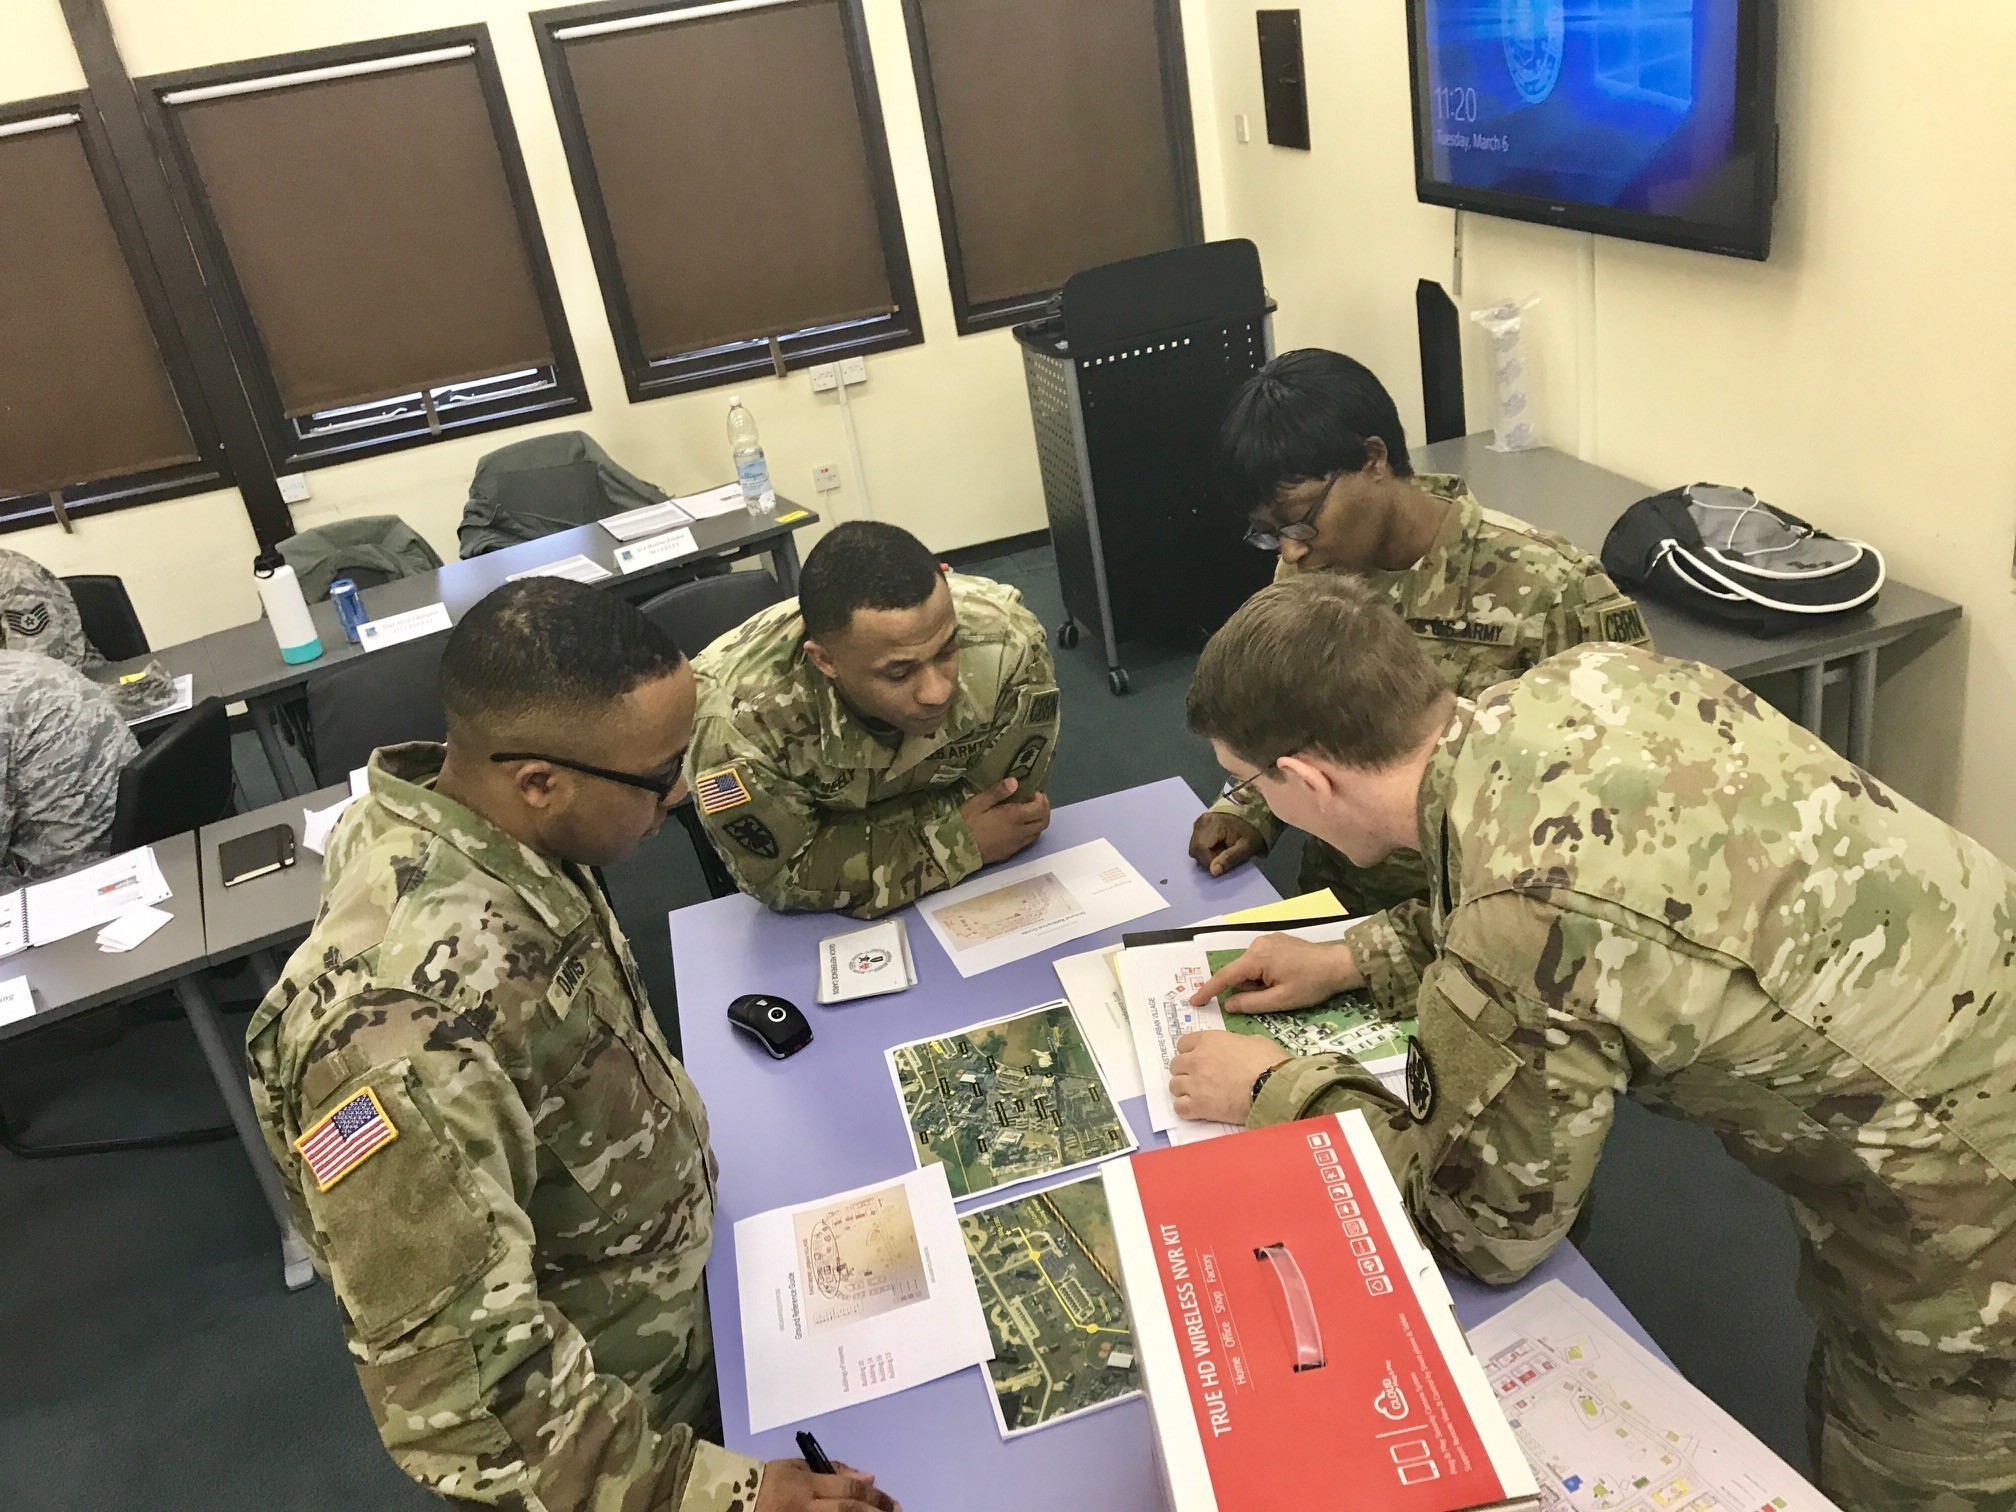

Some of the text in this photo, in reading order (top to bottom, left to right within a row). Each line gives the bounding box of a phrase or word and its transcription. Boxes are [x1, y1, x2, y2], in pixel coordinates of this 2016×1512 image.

[1434, 87, 1477, 122] 11:20
[1437, 130, 1509, 151] Tuesday, March 6
[1464, 622, 1504, 642] ARMY
[1604, 607, 1647, 643] CBRN
[949, 740, 984, 759] ARMY
[556, 955, 585, 997] DAVIS
[830, 956, 839, 980] REFERENCE
[832, 980, 840, 995] CARDS
[1148, 997, 1169, 1069] EASTMERE URBAN VILLAGE
[788, 1272, 802, 1340] Ground Reference Guide
[1160, 1224, 1232, 1437] TRUE HD WIRELESS NVR KIT
[1202, 1254, 1247, 1386] Home Office Shop Factory
[1411, 1370, 1423, 1392] System
[1428, 1378, 1440, 1400] Control
[1382, 1379, 1401, 1410] CLOUD
[1420, 1391, 1432, 1414] Camera
[1441, 1406, 1449, 1421] View
[1439, 1437, 1449, 1451] Play
[1447, 1421, 1460, 1445] Remote
[1443, 1451, 1451, 1459] &
[1447, 1457, 1459, 1475] Plug
[1457, 1444, 1472, 1471] Support
